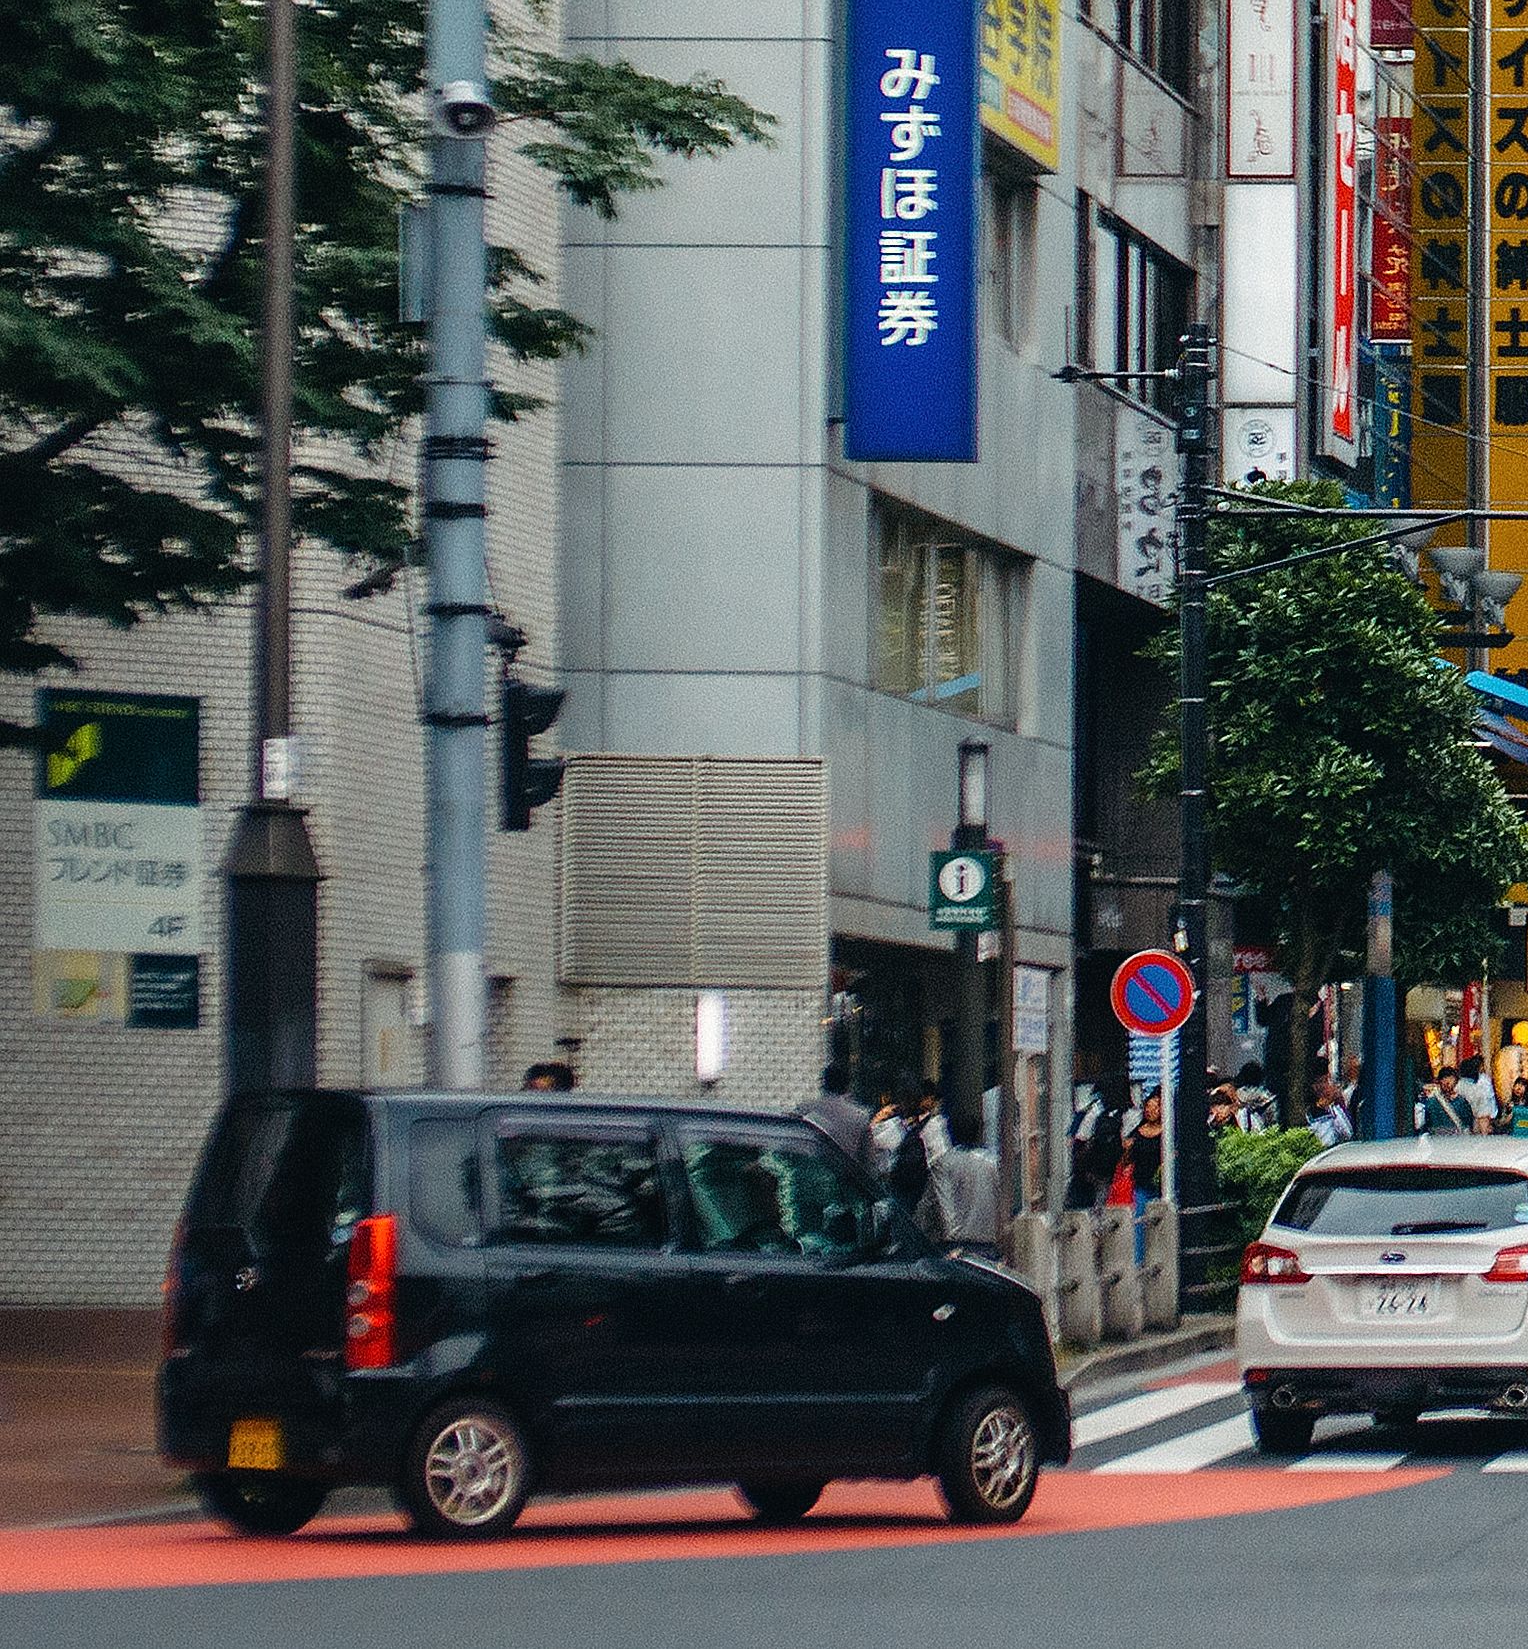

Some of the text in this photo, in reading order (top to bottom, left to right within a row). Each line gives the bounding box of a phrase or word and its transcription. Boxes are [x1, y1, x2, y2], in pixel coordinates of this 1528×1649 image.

[878, 47, 942, 347] みずほ証券
[46, 818, 134, 850] SMBC
[46, 856, 190, 889] フレンド証券
[148, 916, 184, 935] 4F
